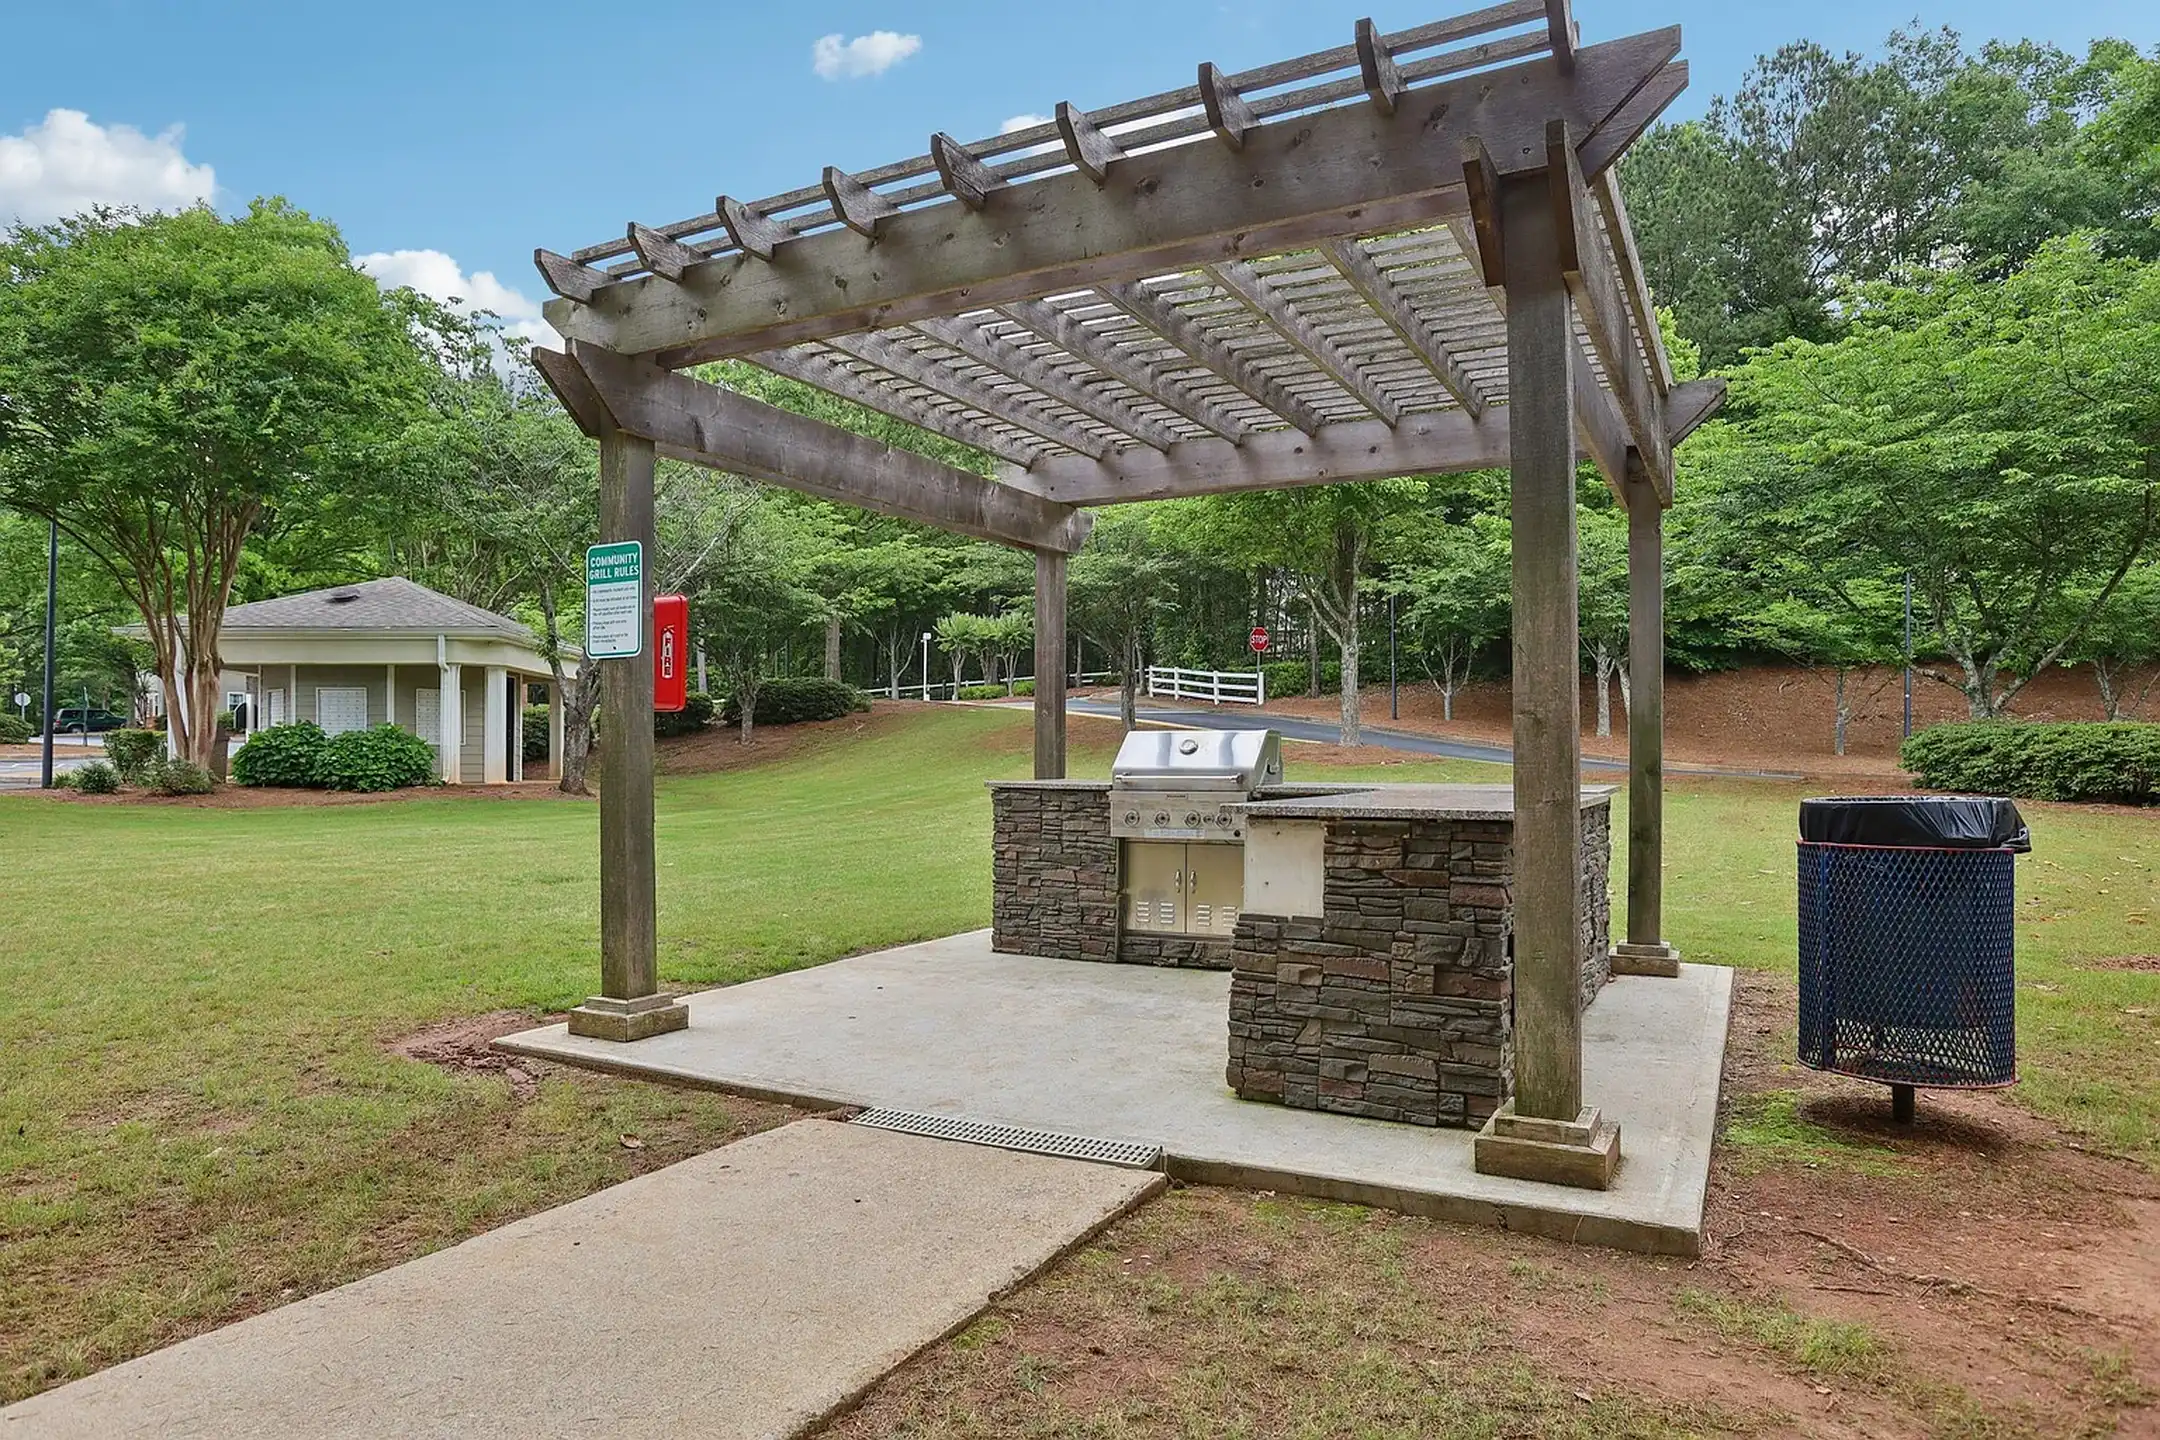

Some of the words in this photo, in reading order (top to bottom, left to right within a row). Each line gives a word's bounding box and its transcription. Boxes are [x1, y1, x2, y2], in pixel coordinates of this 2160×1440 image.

[590, 552, 638, 568] COMMUNITY
[589, 567, 613, 580] GRILL
[613, 564, 640, 578] RULES
[1251, 634, 1268, 644] STOP
[663, 637, 672, 676] FIRE
